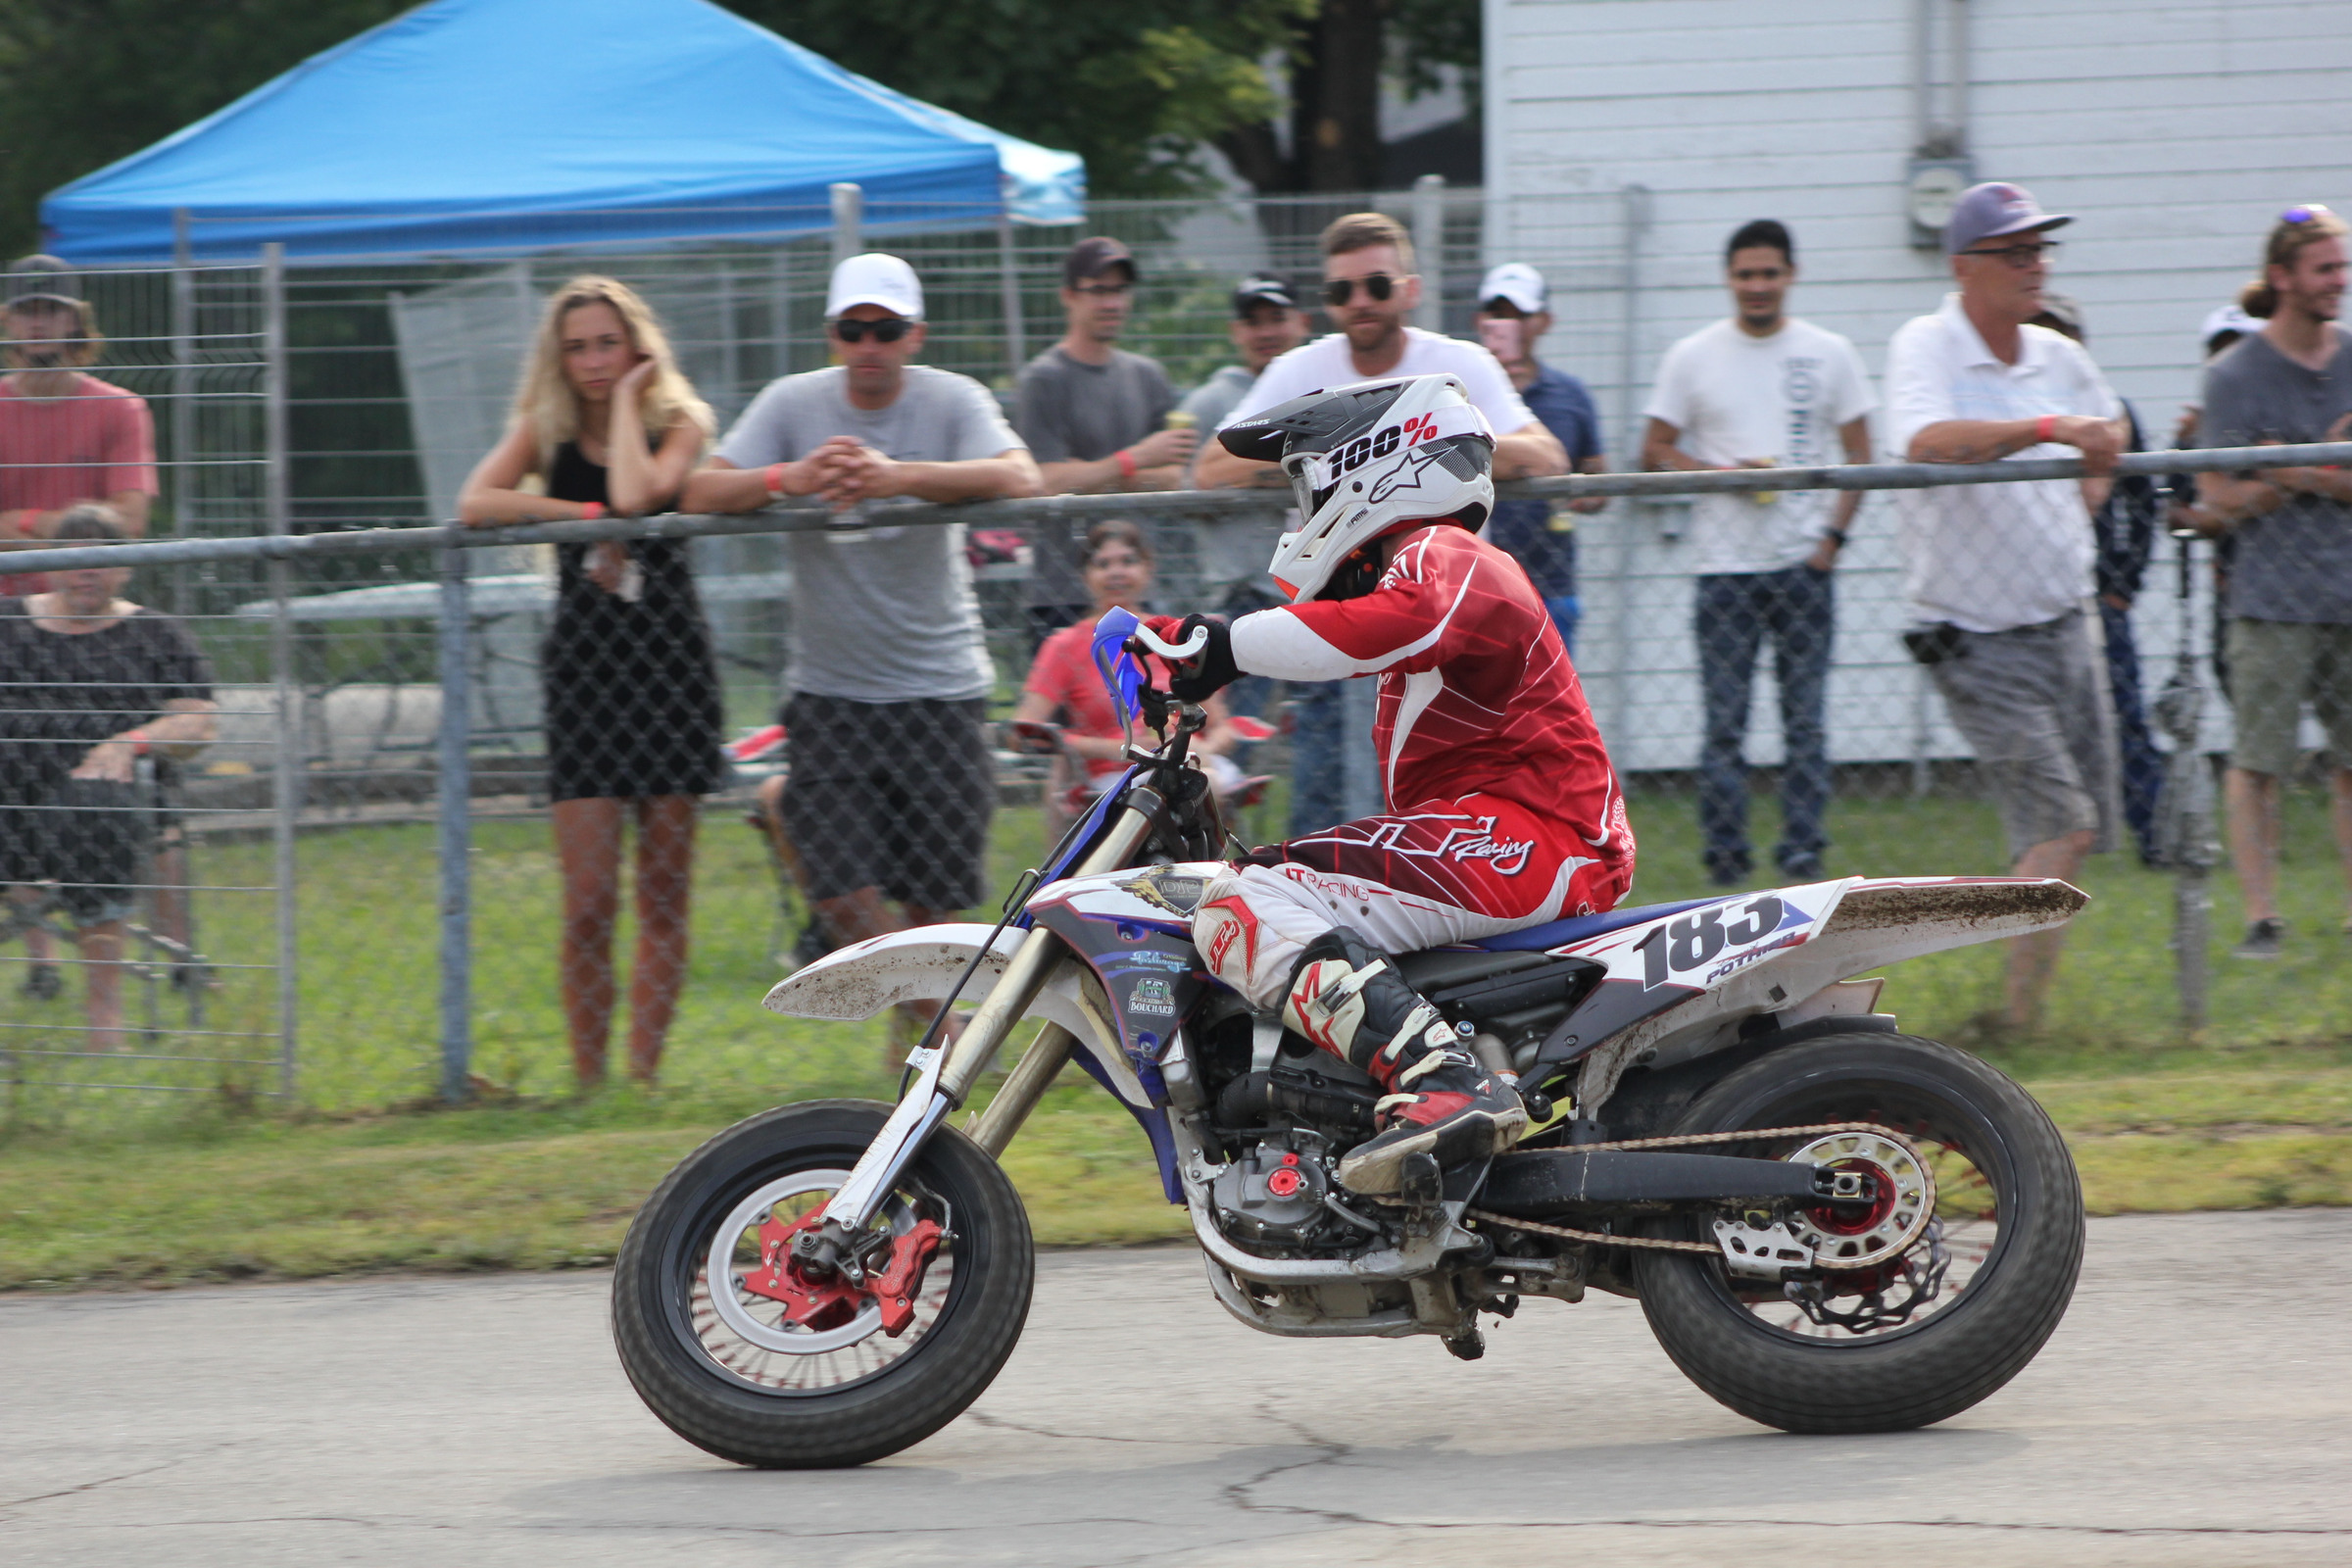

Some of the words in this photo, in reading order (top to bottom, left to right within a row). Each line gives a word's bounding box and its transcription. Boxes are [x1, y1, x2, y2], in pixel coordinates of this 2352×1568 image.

[1327, 413, 1438, 480] 100%
[1448, 835, 1534, 875] Racing
[1632, 896, 1785, 993] 183
[1130, 1001, 1174, 1015] BOUCHARD
